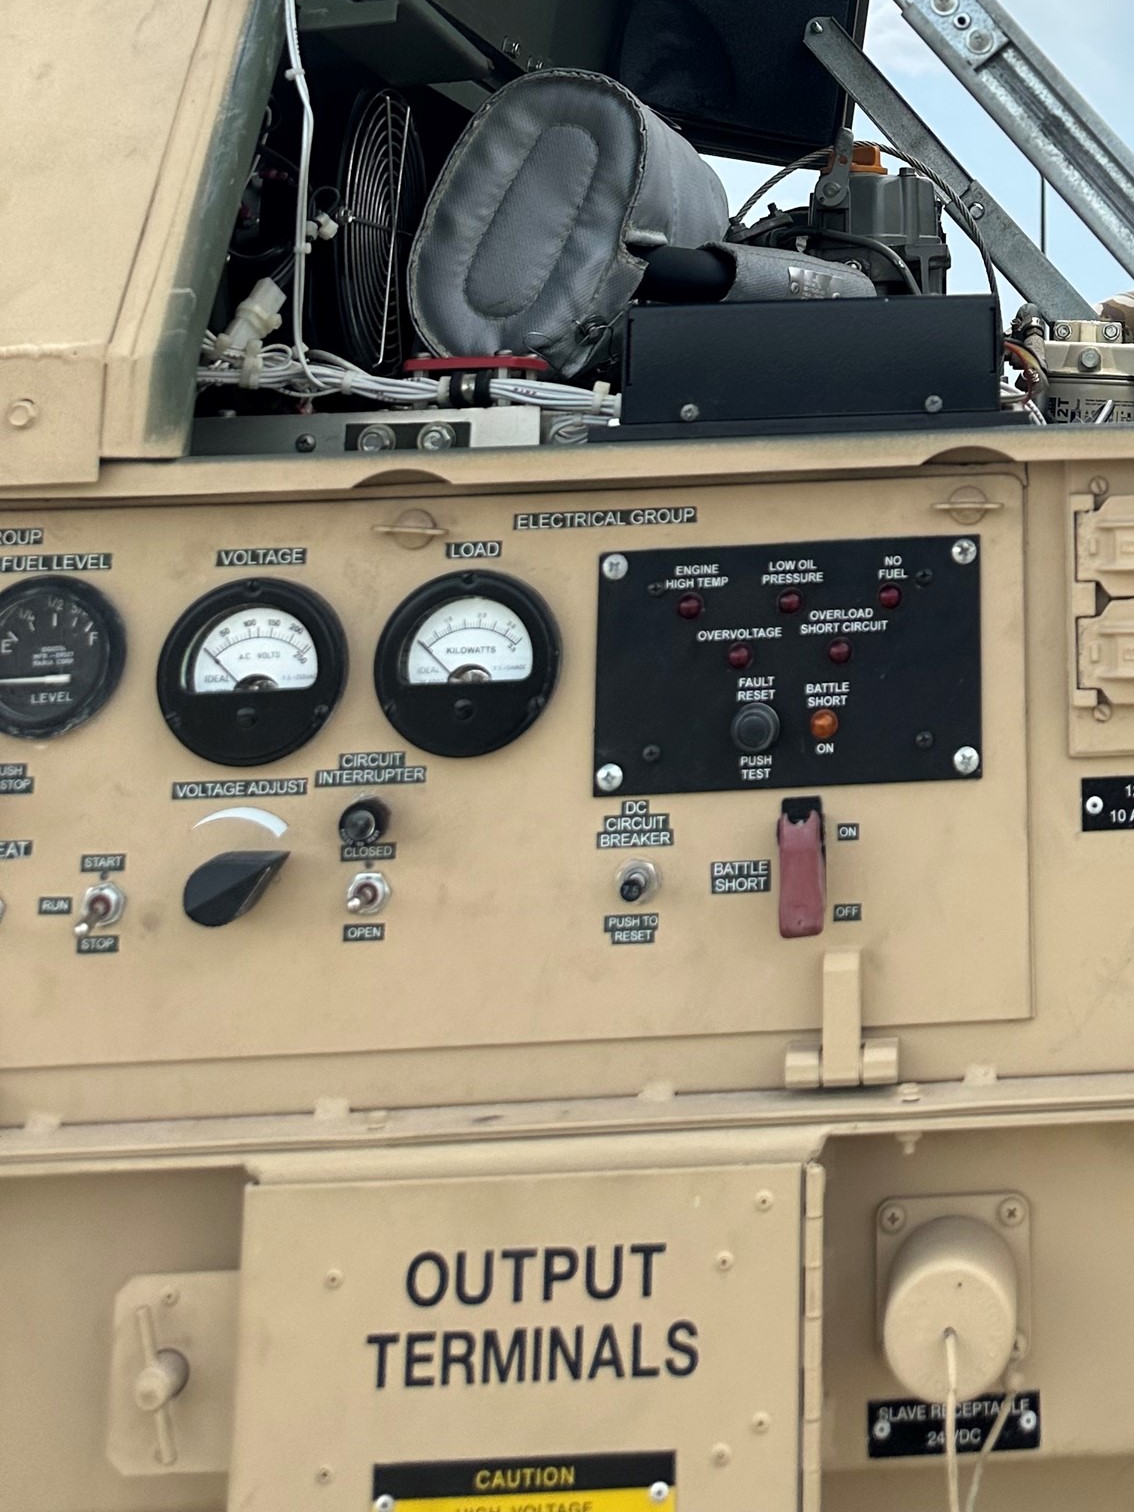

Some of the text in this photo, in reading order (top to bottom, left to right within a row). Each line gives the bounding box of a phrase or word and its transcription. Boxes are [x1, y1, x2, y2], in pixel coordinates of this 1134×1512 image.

[516, 508, 695, 529] ELECTRICAL GROUP
[0, 529, 42, 545] OUP
[220, 548, 304, 565] VOLTAGE
[451, 542, 500, 558] LOAD
[2, 554, 109, 571] FUEL LEVEL
[769, 559, 818, 572] LOW OIL
[884, 556, 902, 566] NO
[675, 564, 720, 576] ENGINE
[878, 568, 908, 580] FUEL
[666, 577, 729, 589] HIGH TEMP
[762, 572, 824, 585] PRESSURE
[810, 608, 873, 621] OVERLOAD
[697, 627, 783, 641] OVERVOLTAGE
[801, 620, 889, 635] SHORT CIRCUIT
[446, 646, 497, 655] KILOWATTS
[738, 676, 775, 688] FAULT
[806, 682, 850, 695] BATTLE
[31, 692, 73, 704] LEVEL
[737, 689, 775, 702] RESET
[807, 695, 848, 708] SHORT
[816, 743, 834, 754] ON
[342, 753, 402, 767] CIRCUIT
[740, 755, 772, 767] PUSH
[318, 768, 425, 785] INTERRUPTER
[742, 769, 771, 781] TEST
[177, 780, 306, 798] VOLTAGE ADJUST
[625, 801, 647, 814] DC
[1110, 810, 1126, 823] 10
[606, 816, 666, 831] CIRCUIT
[839, 826, 857, 837] ON
[600, 832, 671, 847] BREAKER
[344, 845, 393, 858] CLOSED
[84, 856, 123, 868] START
[714, 861, 769, 876] BATTLE
[715, 877, 767, 891] SHORT
[42, 900, 69, 911] RUN
[836, 906, 859, 918] OFF
[609, 914, 658, 928] PUSH TO
[347, 926, 381, 938] OPEN
[614, 930, 652, 942] RESET
[81, 938, 115, 950] STOP
[406, 1242, 667, 1307] OUTPUT
[366, 1319, 699, 1389] TERMINALS
[878, 1398, 1030, 1421] SLAVE RCEPTALE
[475, 1466, 575, 1489] CAUTION
